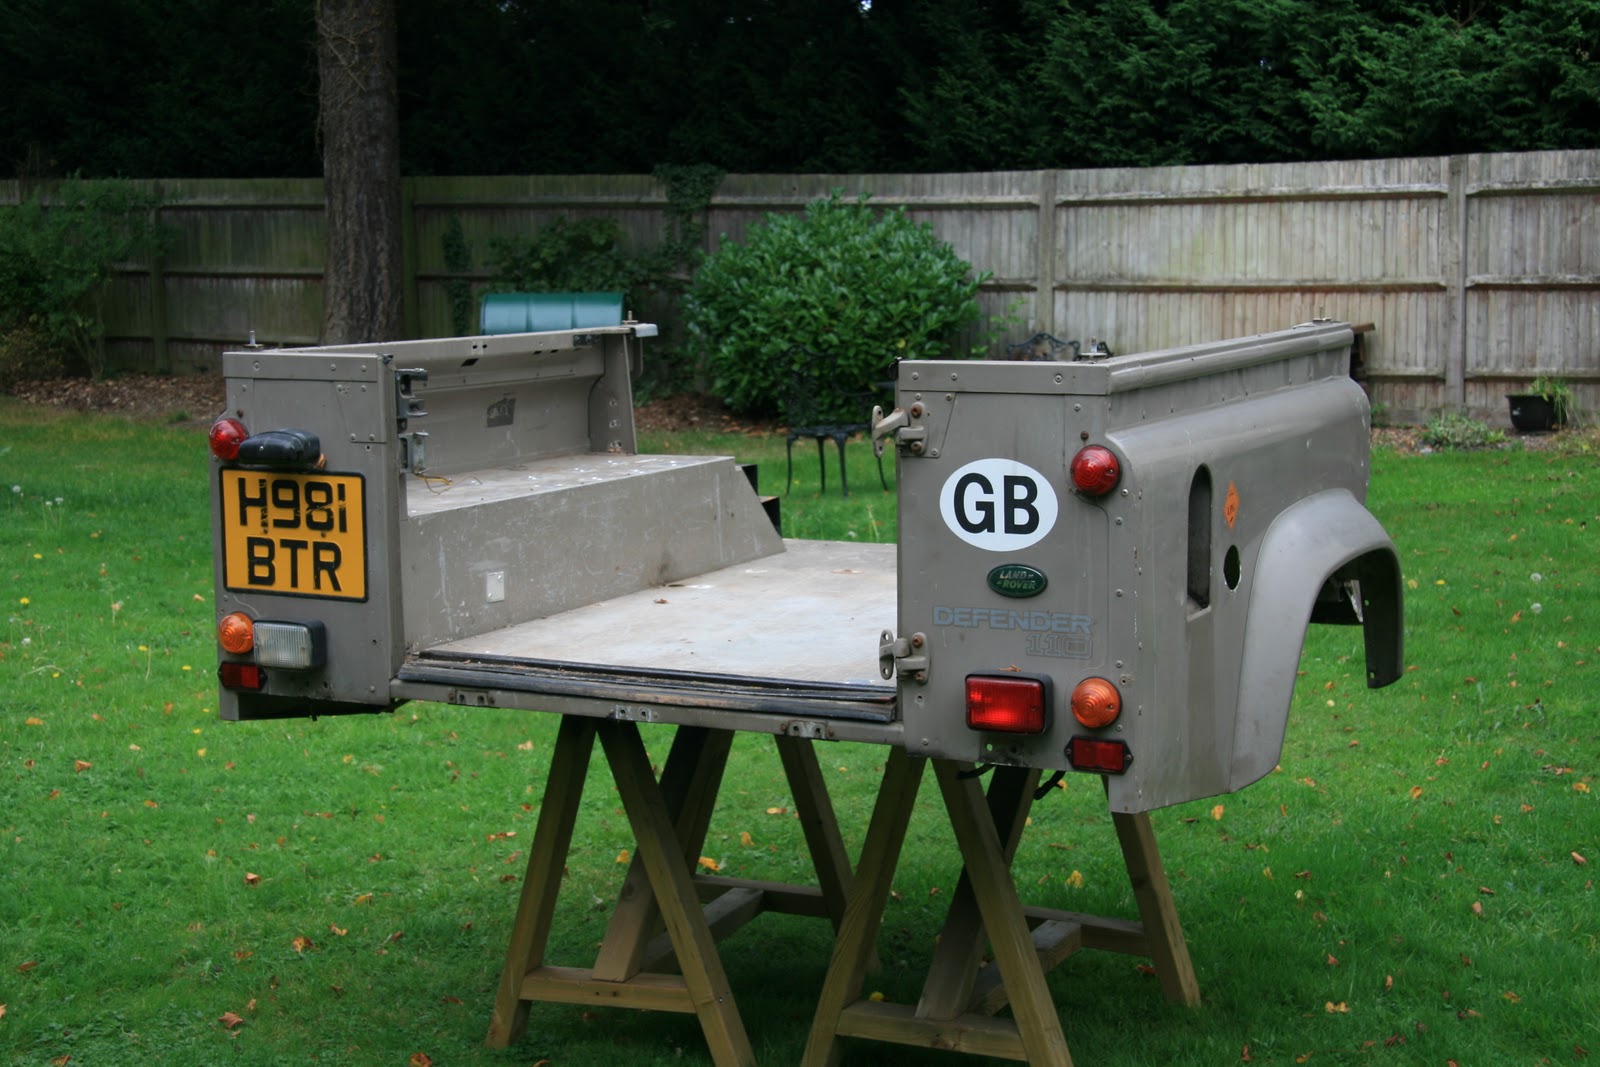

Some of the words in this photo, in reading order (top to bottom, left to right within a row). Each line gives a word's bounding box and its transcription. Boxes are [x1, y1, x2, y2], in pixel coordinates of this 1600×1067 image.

[238, 477, 347, 533] H981
[953, 472, 1040, 535] GB
[246, 536, 342, 592] BTR
[999, 570, 1027, 580] LAND
[1002, 580, 1037, 590] ROVER
[932, 606, 1093, 634] DEFENDER
[1026, 633, 1093, 660] 110
